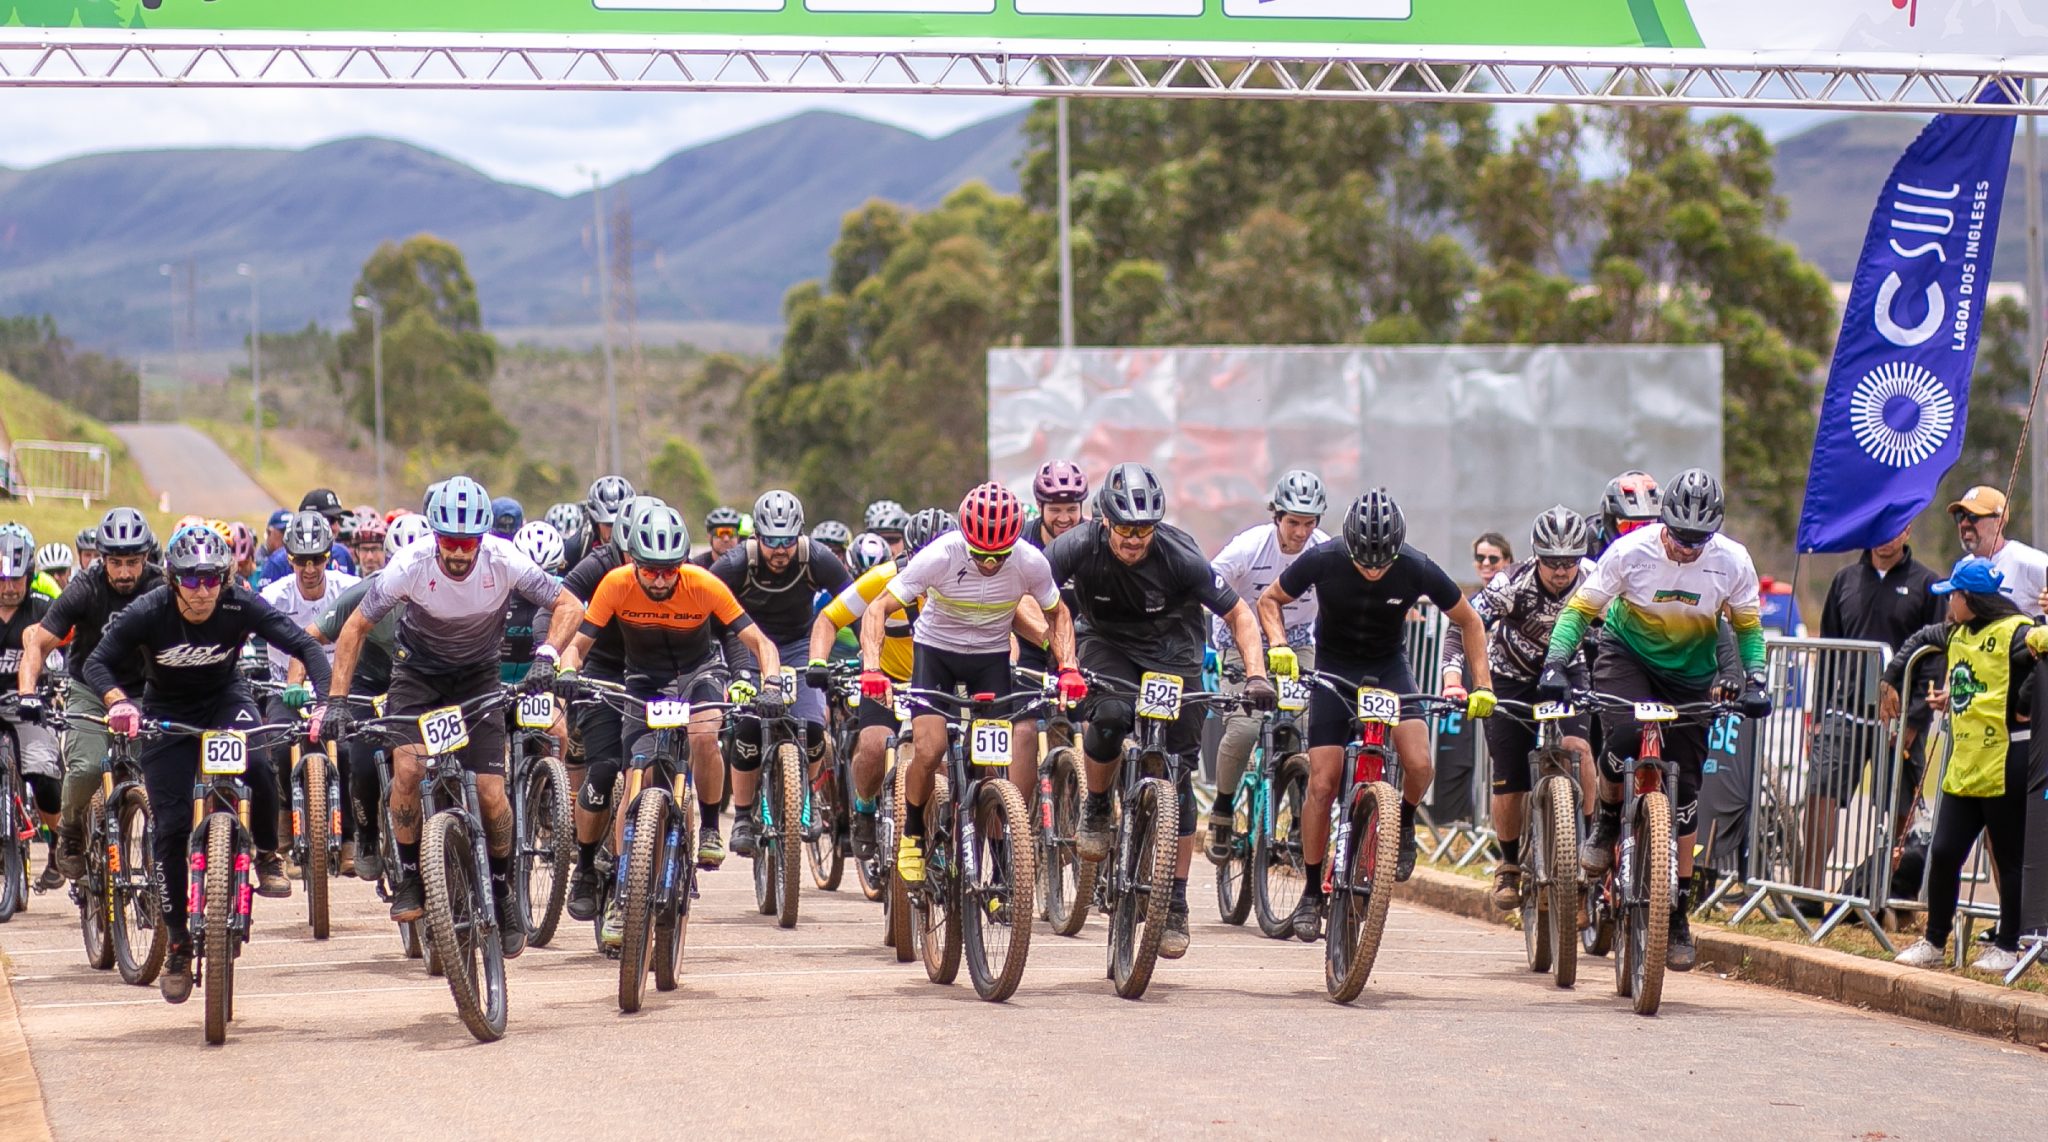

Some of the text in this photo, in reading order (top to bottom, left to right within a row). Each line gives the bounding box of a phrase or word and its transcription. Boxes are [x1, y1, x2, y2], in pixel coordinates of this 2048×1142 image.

[1952, 180, 1989, 351] LAGOA DOS INGLESES
[522, 698, 551, 716] 609
[1145, 683, 1178, 708] 525
[1364, 696, 1395, 717] 529
[426, 715, 462, 744] 526
[976, 730, 1007, 753] 519
[207, 742, 242, 762] 520
[155, 862, 173, 913] NOMAD
